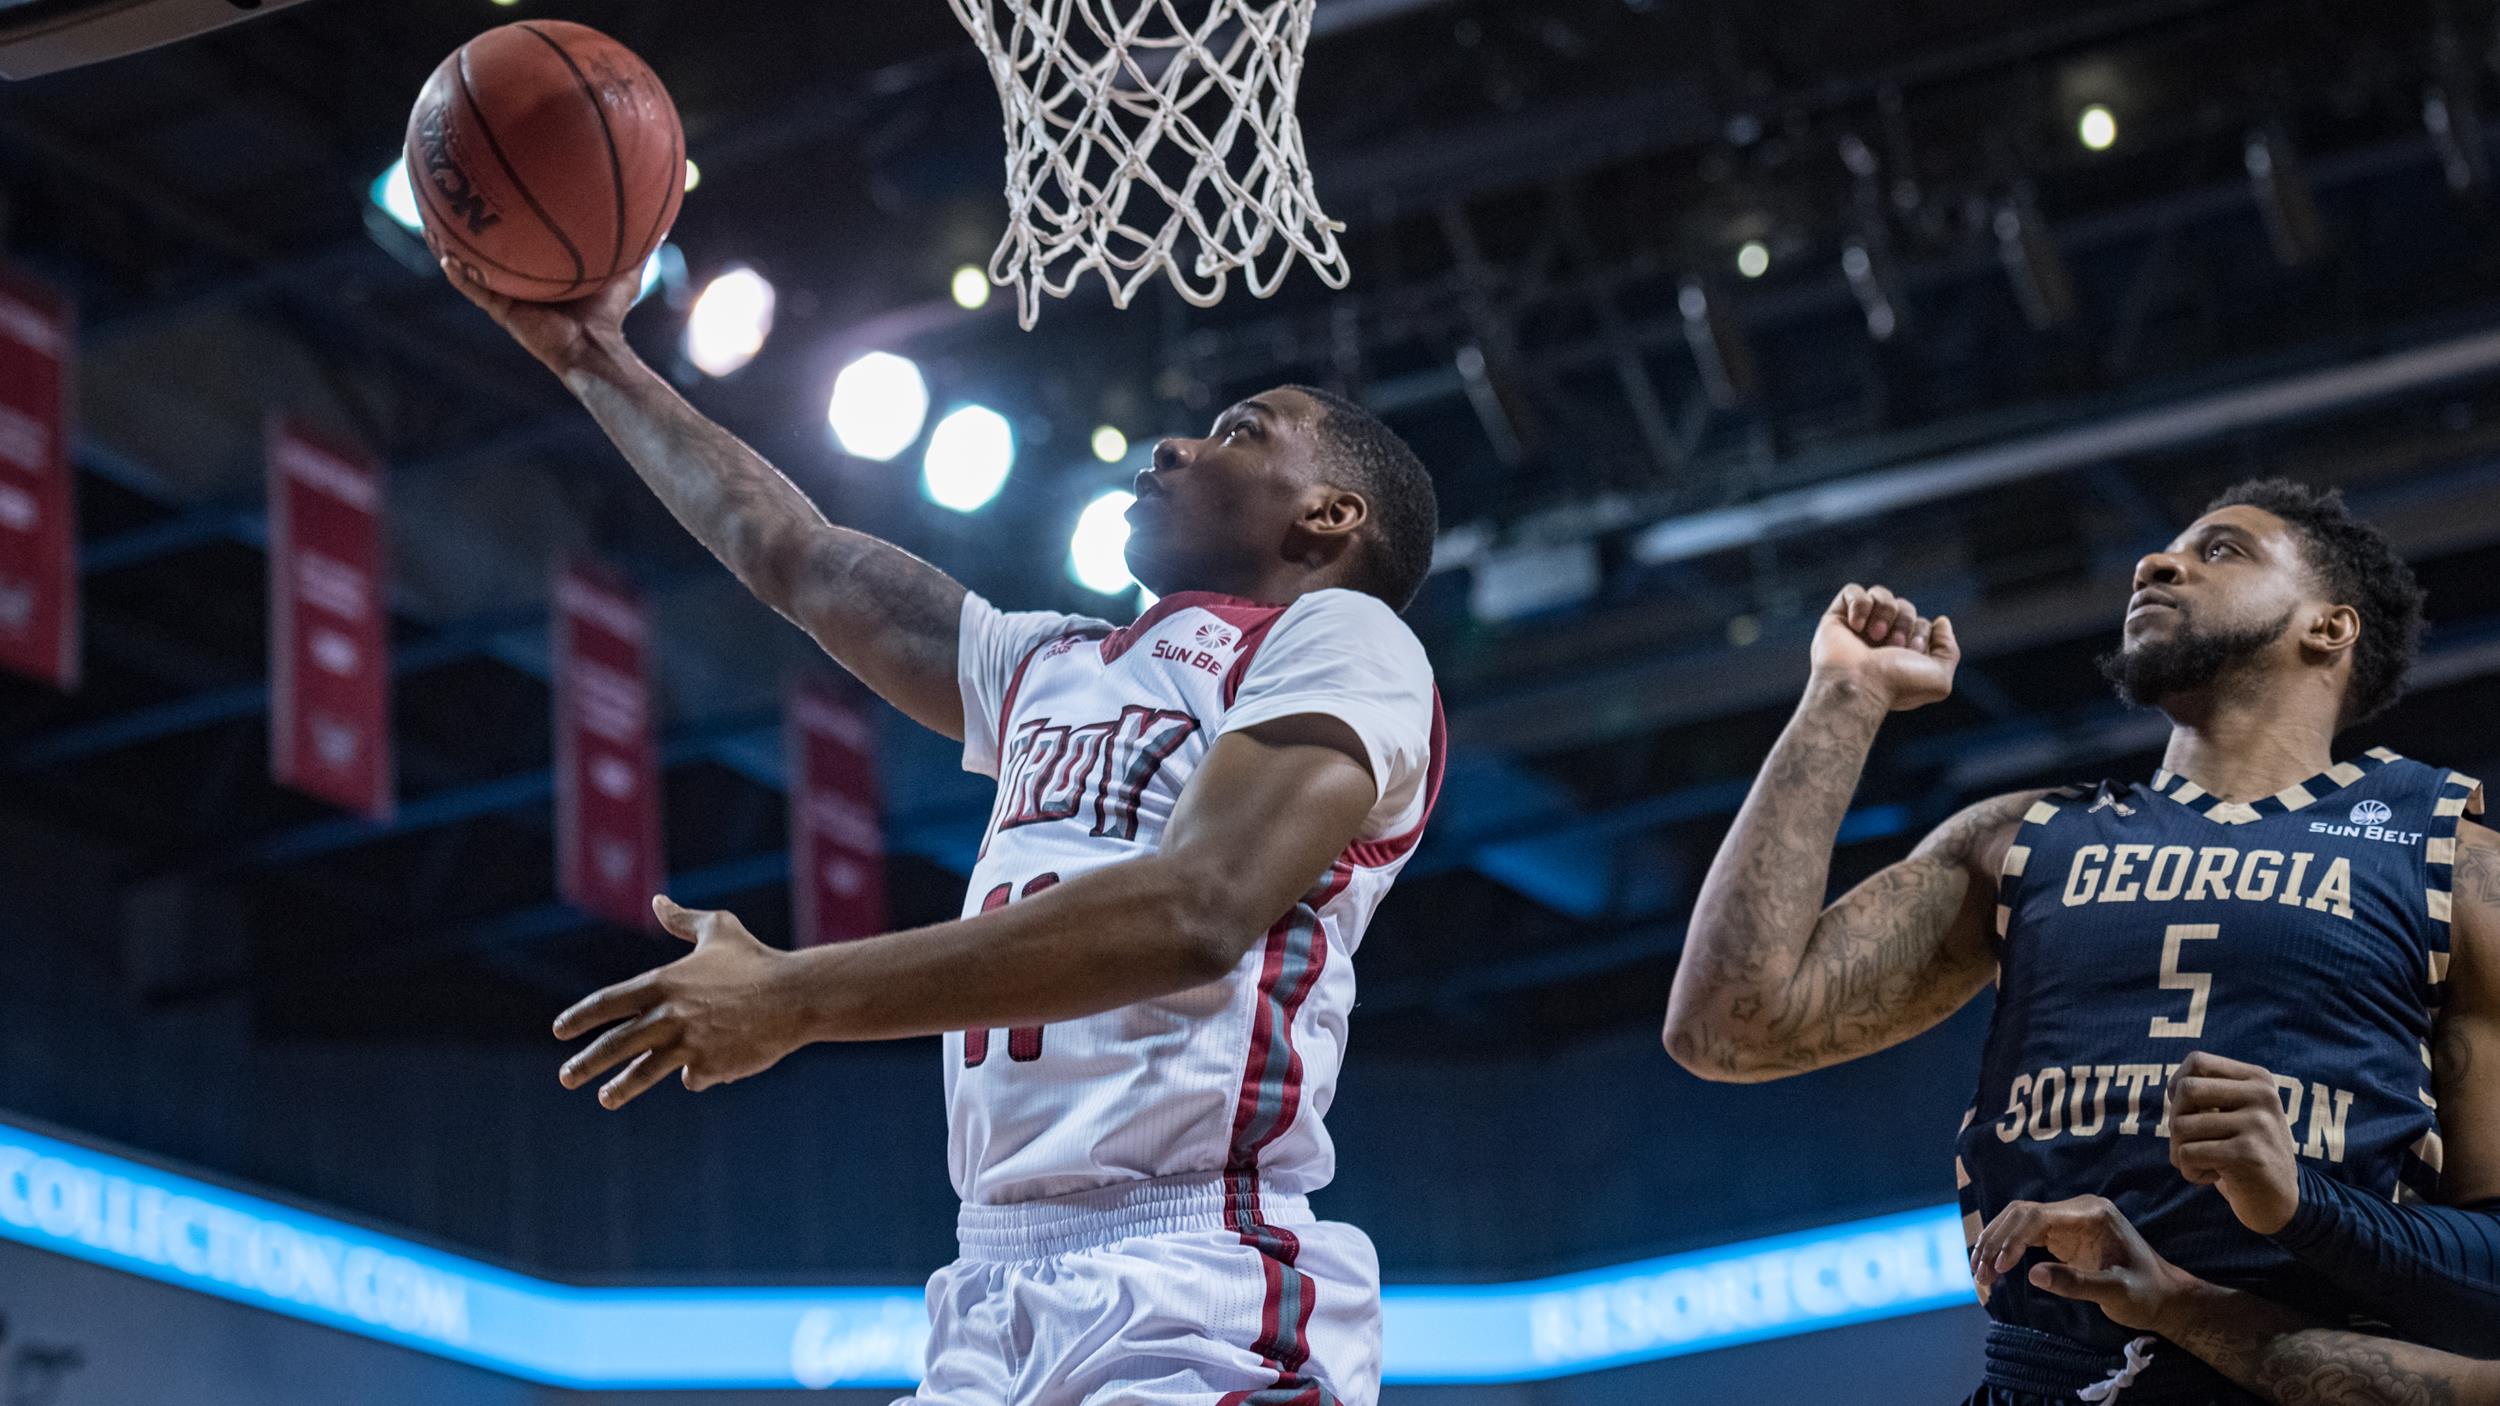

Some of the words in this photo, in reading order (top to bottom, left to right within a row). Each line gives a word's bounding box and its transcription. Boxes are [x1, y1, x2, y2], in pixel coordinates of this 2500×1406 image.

[1151, 639, 1192, 663] SUN
[1191, 650, 1223, 677] BE
[2308, 821, 2361, 838] SUN
[2363, 826, 2423, 846] BELT
[2062, 844, 2355, 920] GEORGIA
[2148, 923, 2221, 1038] 5
[1995, 1063, 2354, 1164] SOUTRN
